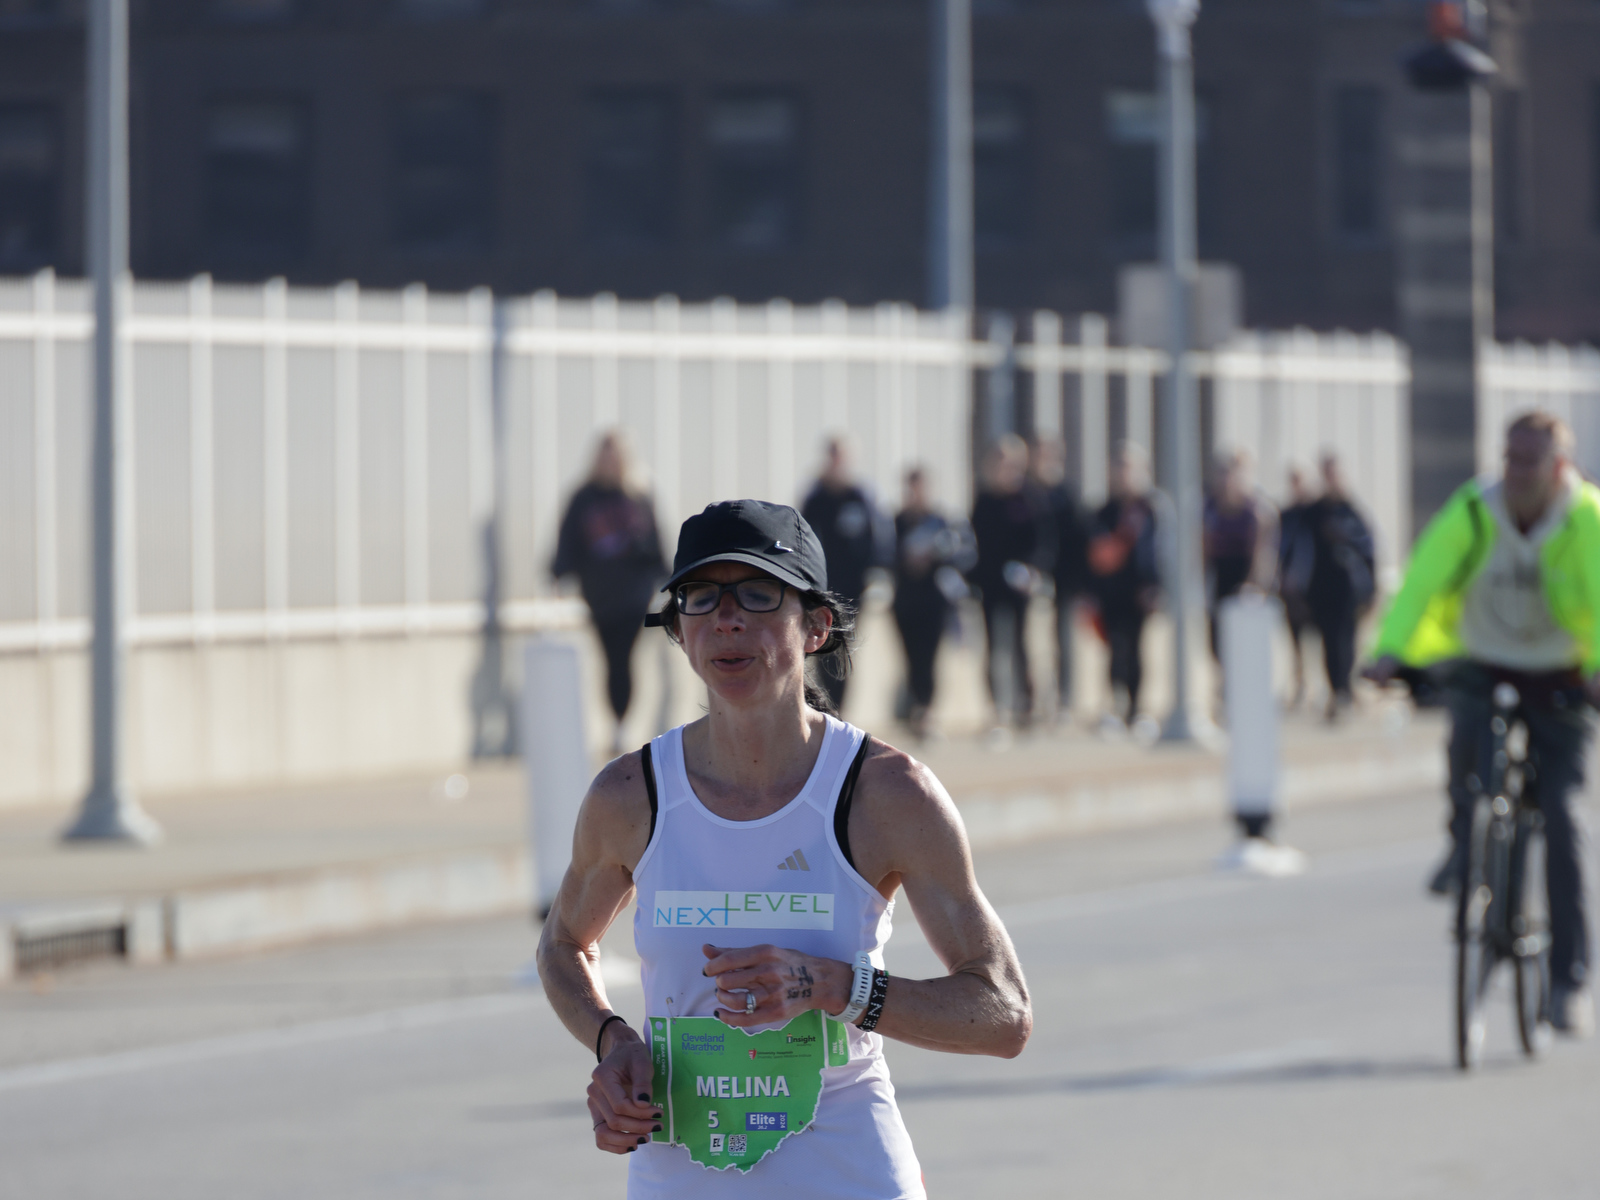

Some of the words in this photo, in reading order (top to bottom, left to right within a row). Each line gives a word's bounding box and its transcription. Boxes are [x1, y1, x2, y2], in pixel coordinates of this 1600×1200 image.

[655, 907, 729, 926] NEXT
[725, 893, 830, 914] LEVEL
[682, 1033, 724, 1042] Cleveland
[682, 1042, 724, 1051] Marathon
[696, 1075, 791, 1099] MELINA
[708, 1110, 719, 1128] 5
[749, 1113, 776, 1125] Elite
